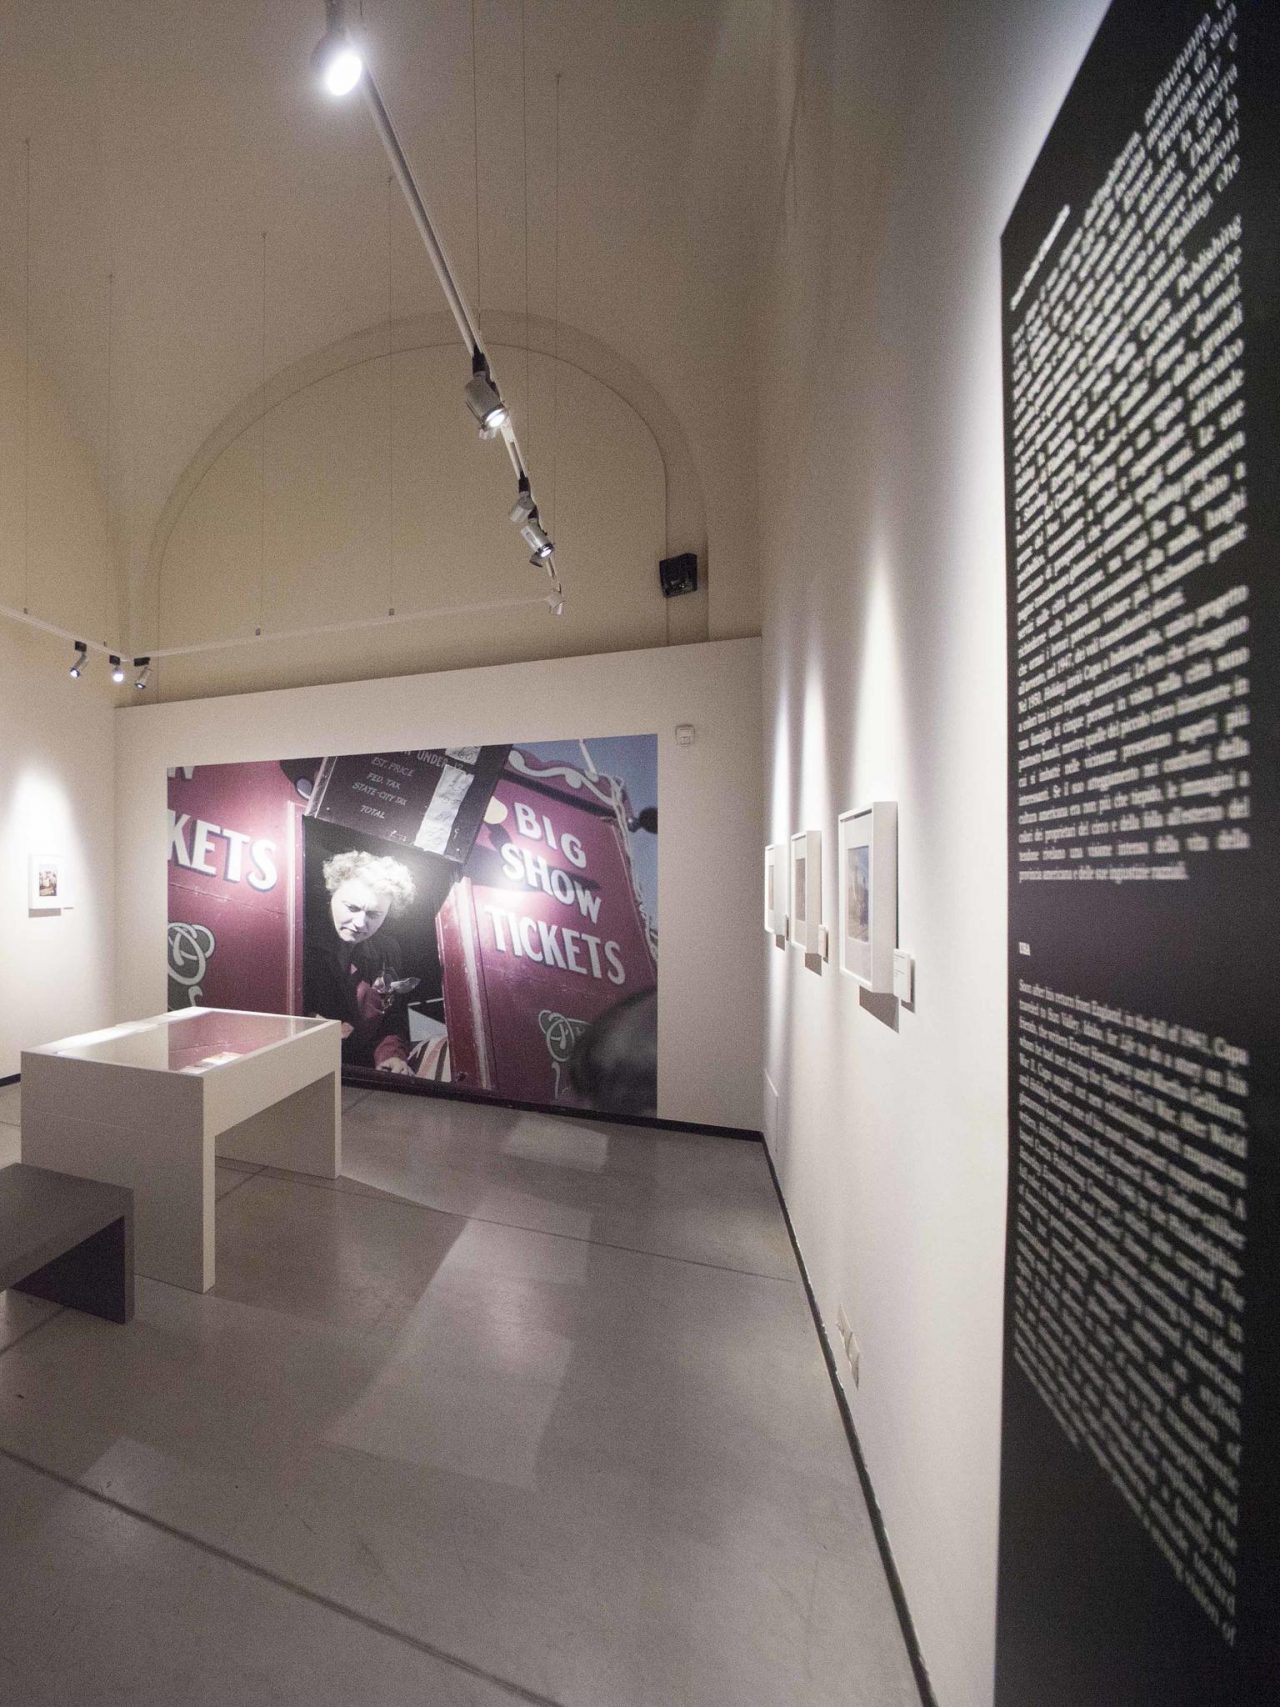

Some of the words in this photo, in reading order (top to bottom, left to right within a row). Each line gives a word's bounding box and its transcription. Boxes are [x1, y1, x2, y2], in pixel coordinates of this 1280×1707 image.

[1209, 3, 1237, 50] Sun
[1190, 117, 1222, 168] Dopo
[1225, 94, 1239, 120] la
[1196, 64, 1238, 135] guerra
[1215, 154, 1240, 192] che
[1177, 216, 1242, 298] Publishing
[1202, 246, 1242, 298] anche
[1220, 400, 1244, 430] sue
[360, 804, 386, 820] TOTAL
[365, 772, 384, 785] FED.
[386, 777, 401, 790] TAX
[167, 808, 278, 891] KETS
[514, 801, 587, 869] BIG
[501, 841, 602, 924] SHOW
[483, 904, 627, 985] TICKETS
